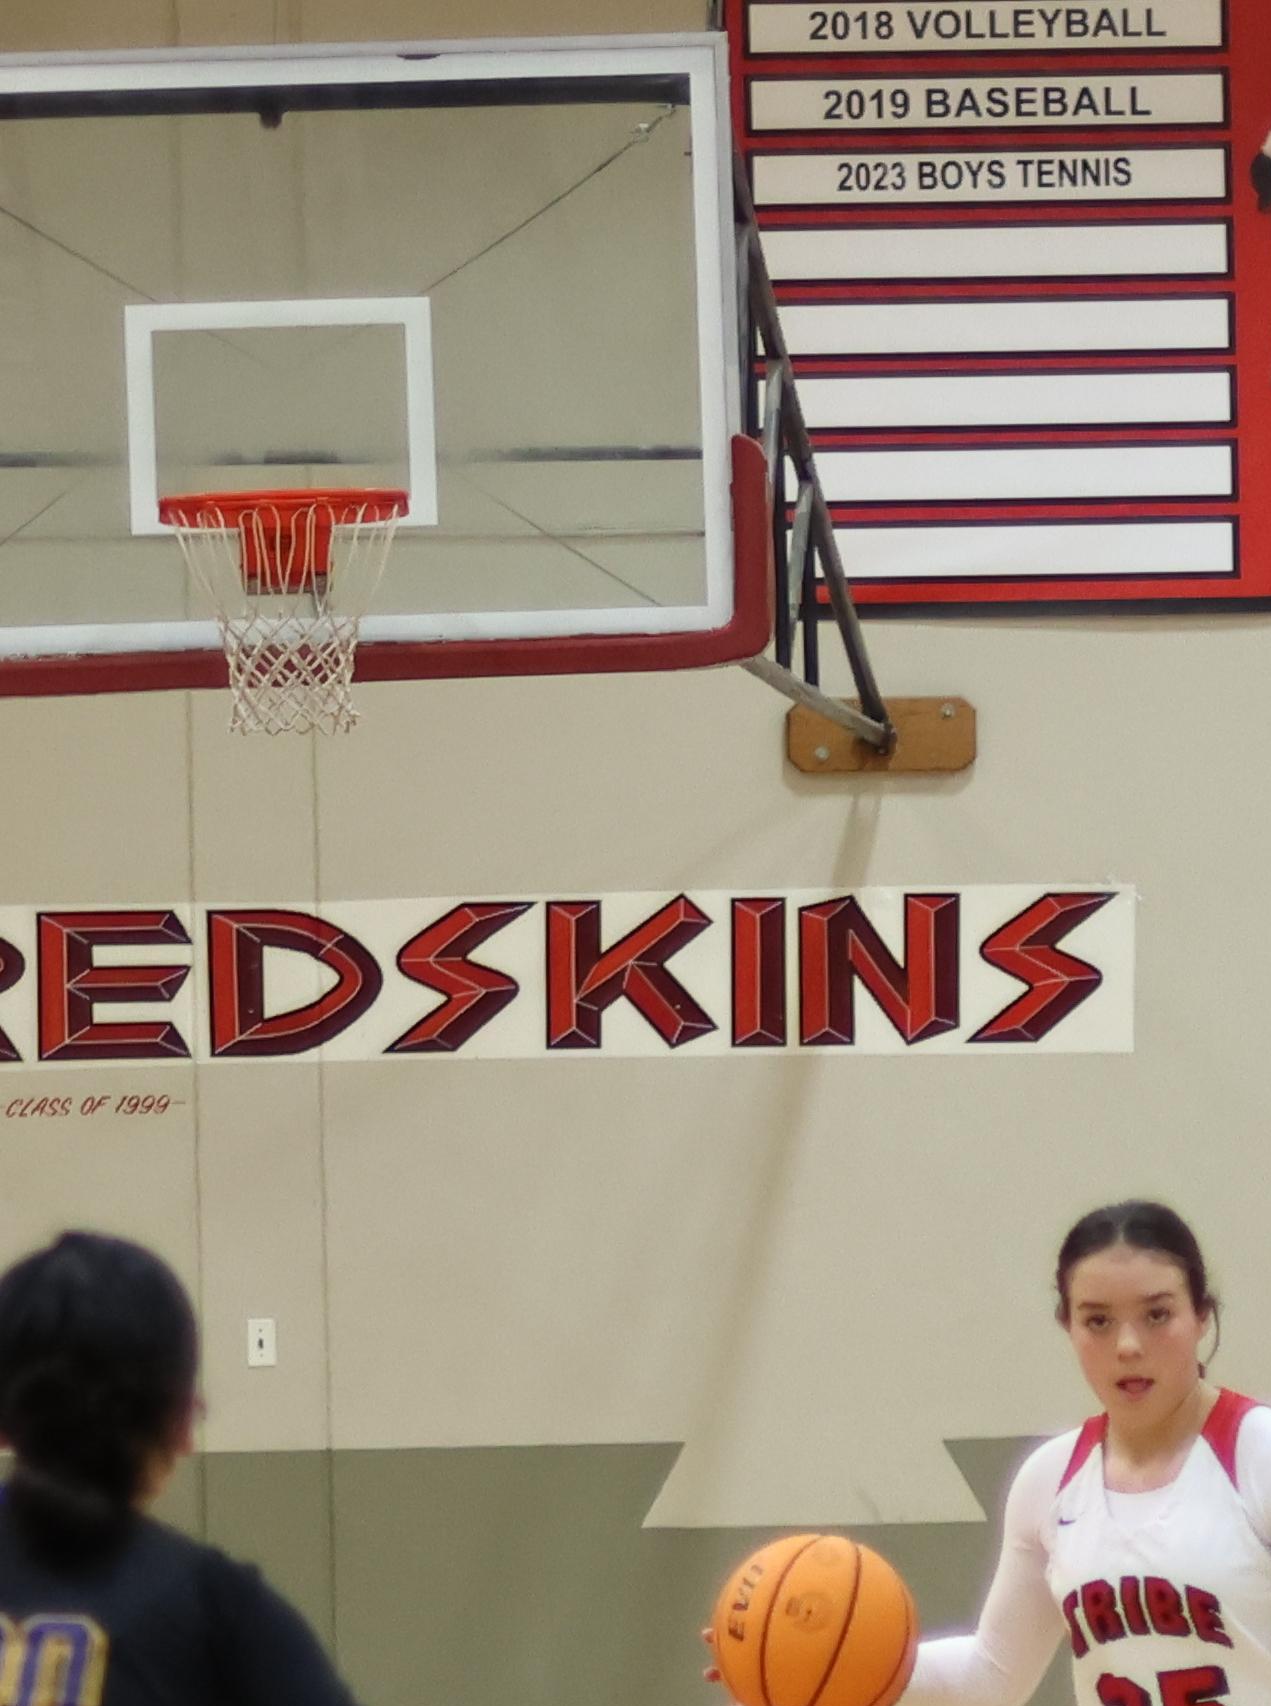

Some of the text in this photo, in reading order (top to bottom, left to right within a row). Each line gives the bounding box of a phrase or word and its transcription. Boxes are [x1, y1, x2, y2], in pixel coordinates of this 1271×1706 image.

[809, 8, 1167, 40] 2018 VOLLEYBALL
[824, 86, 1151, 120] 2019 BASEBALL
[837, 157, 1131, 191] 2023 BOYS TENNIS
[0, 893, 1119, 1062] EDSKINS
[6, 1094, 171, 1118] CLASS OF 1999
[1062, 1575, 1234, 1659] TRIBE
